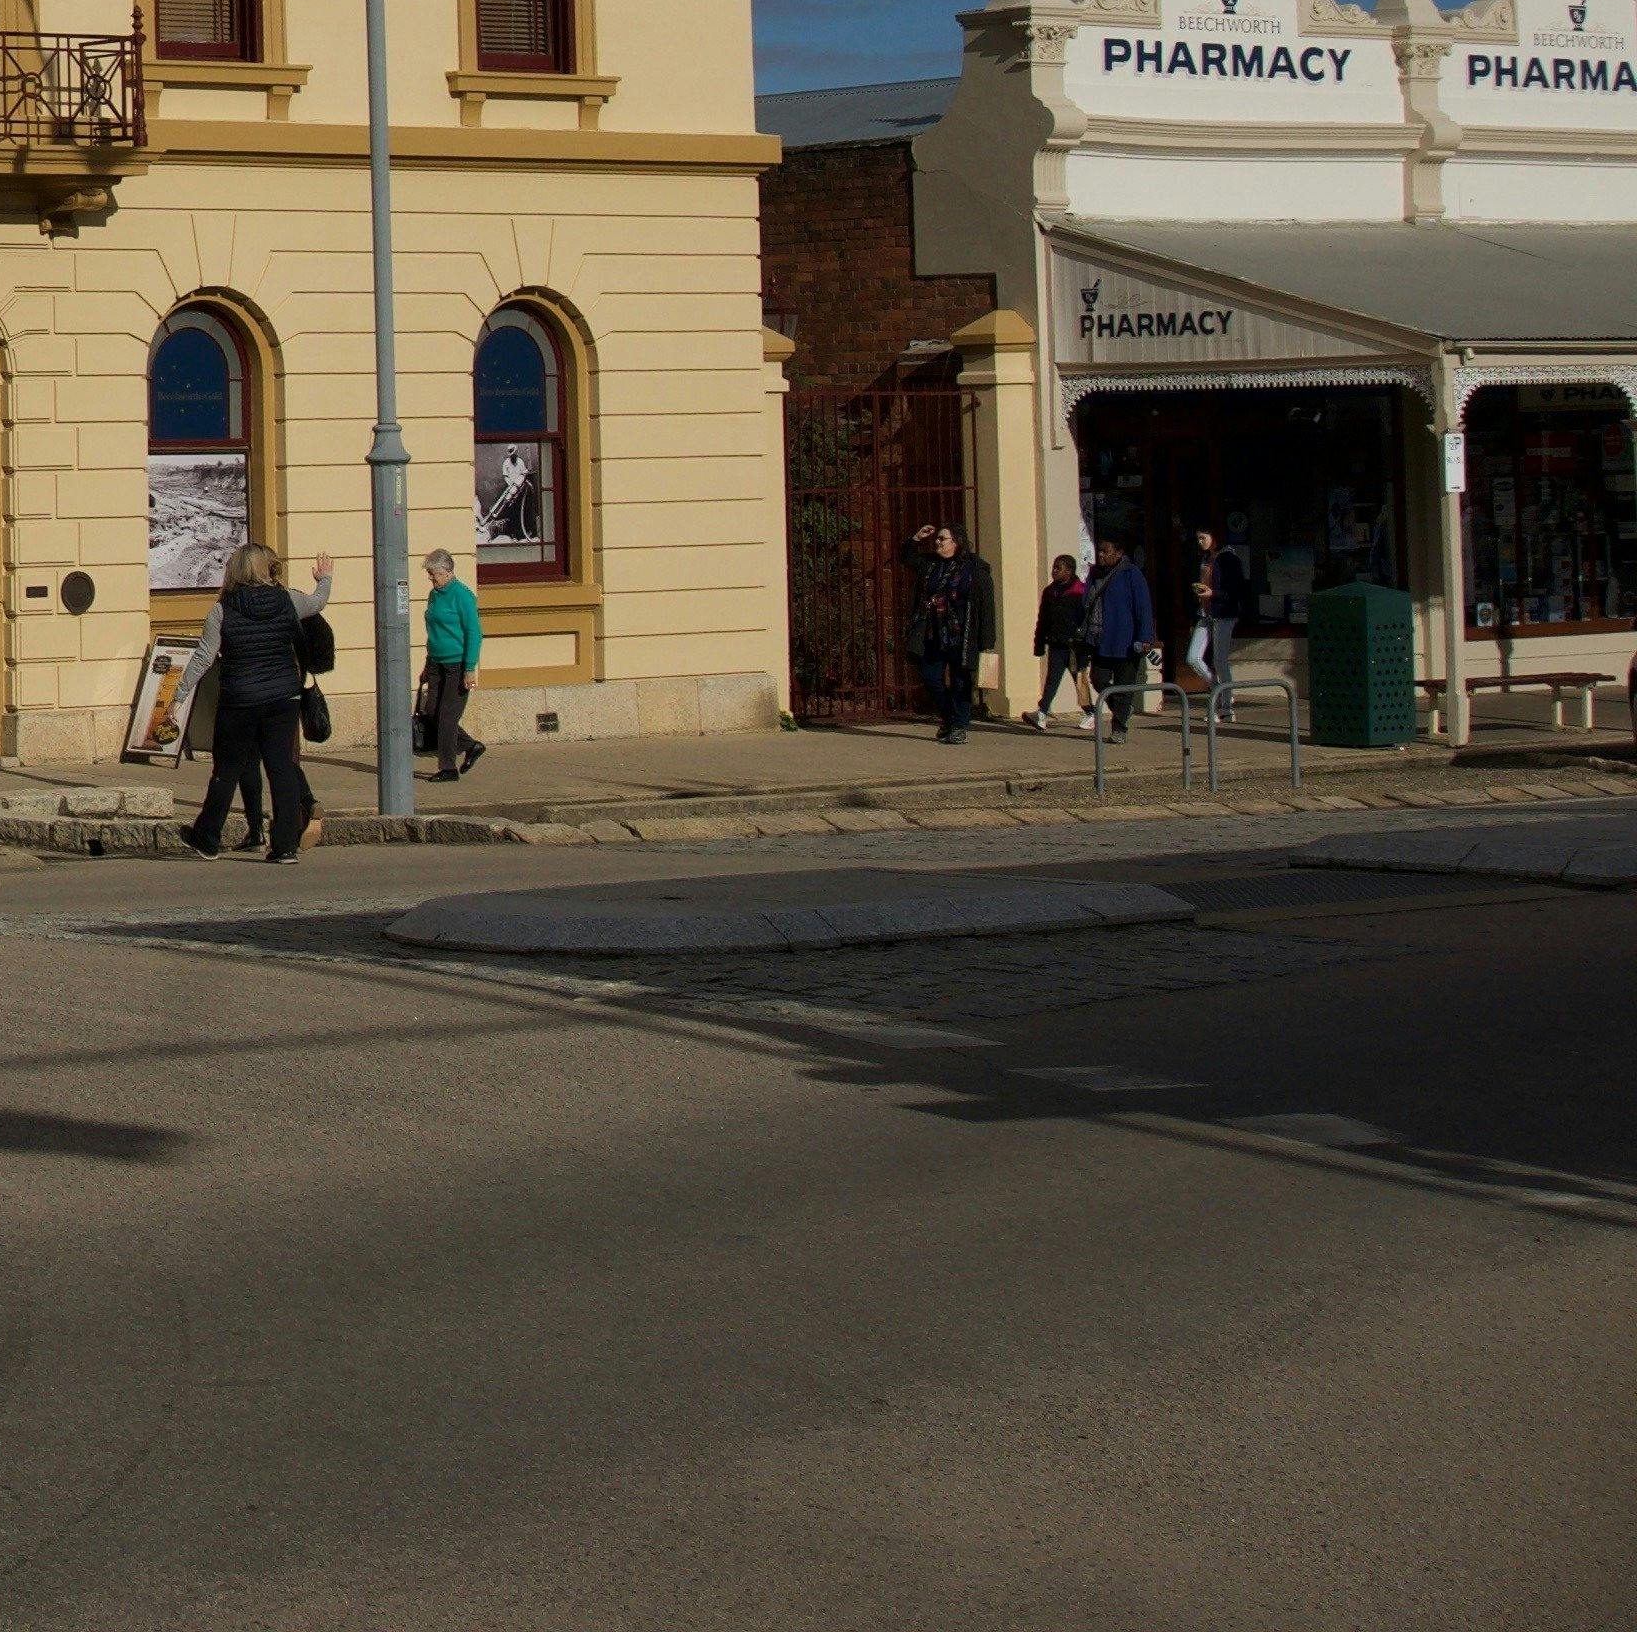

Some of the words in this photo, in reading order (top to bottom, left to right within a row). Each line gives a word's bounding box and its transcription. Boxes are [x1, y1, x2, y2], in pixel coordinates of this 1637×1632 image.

[1178, 16, 1282, 35] BEECHWORTH
[1533, 32, 1626, 51] BEECHWORTH
[1103, 37, 1352, 83] PHARMACY
[1468, 54, 1637, 92] PHARMA
[1079, 310, 1233, 339] PHARMACY
